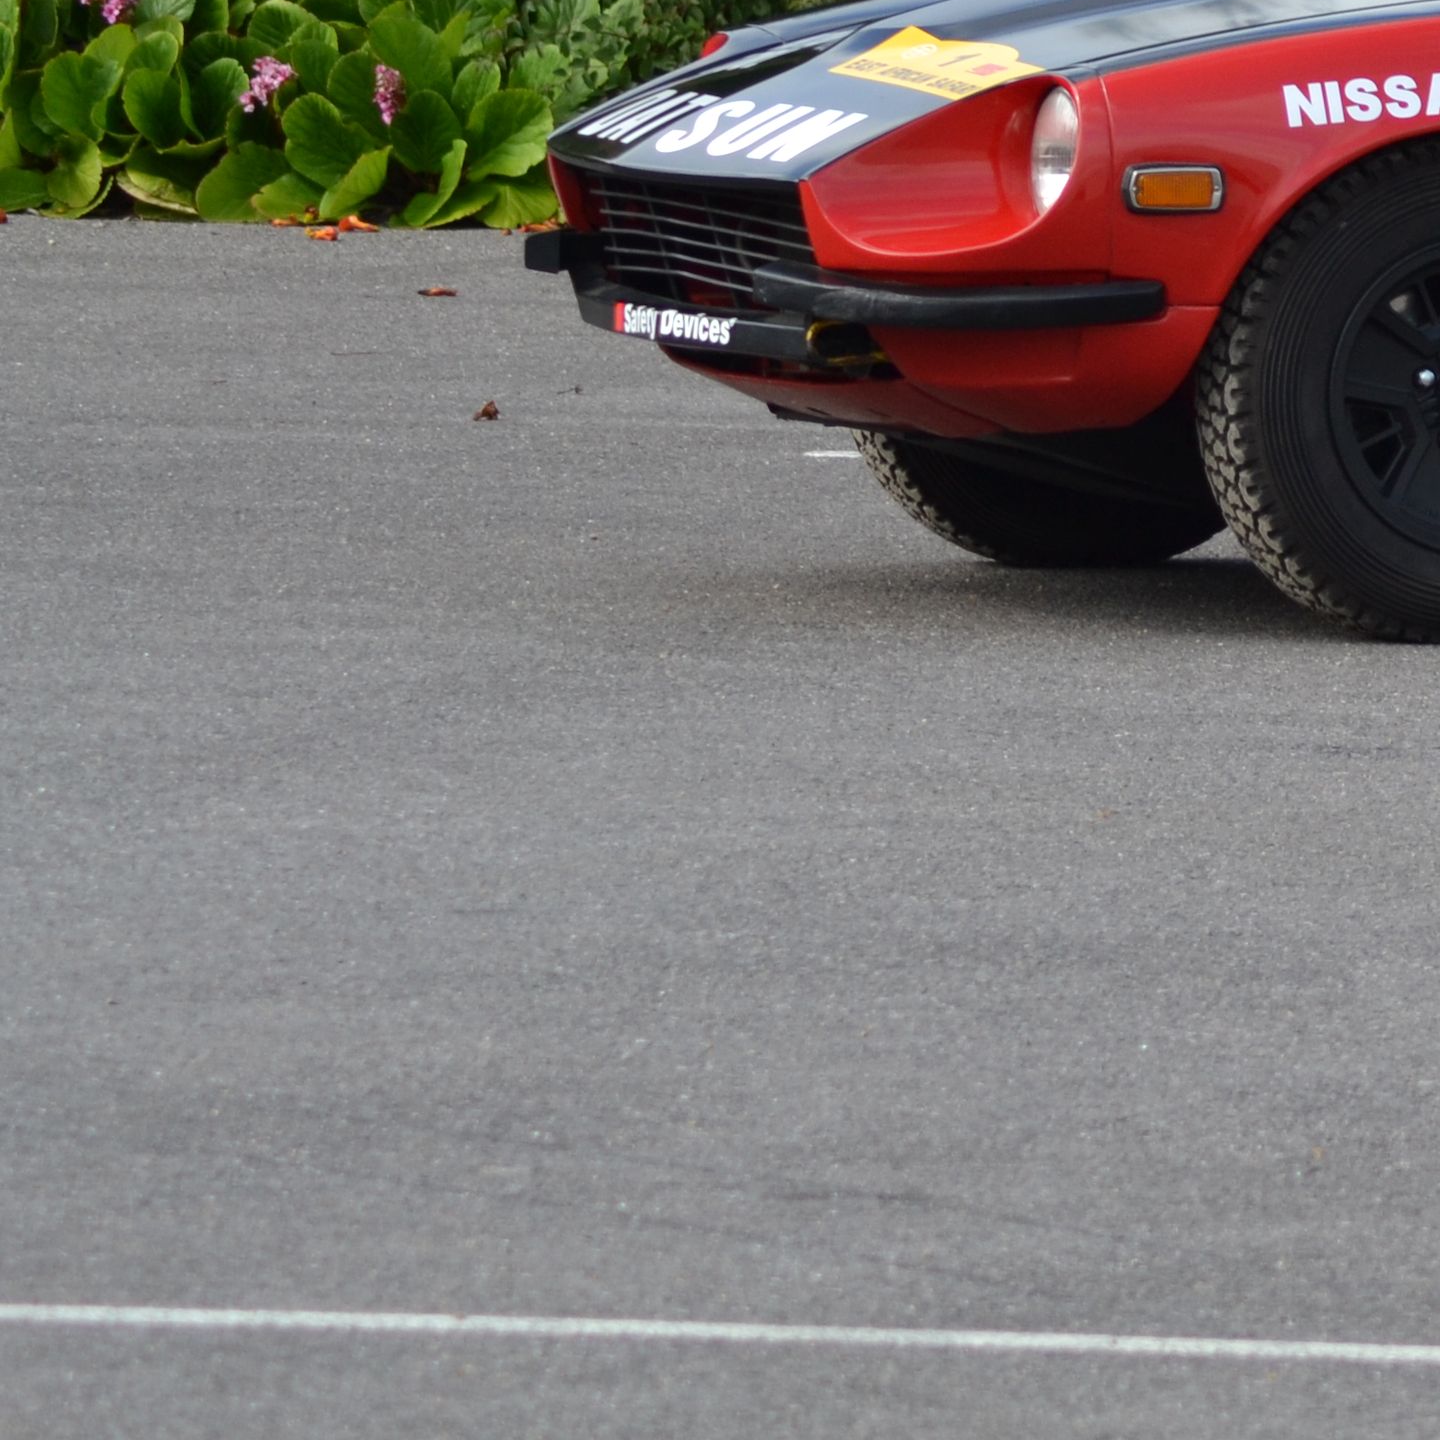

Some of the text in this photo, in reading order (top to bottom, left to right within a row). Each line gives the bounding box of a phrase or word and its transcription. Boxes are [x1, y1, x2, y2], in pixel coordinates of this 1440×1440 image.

[577, 89, 869, 162] DATSUN
[623, 303, 733, 346] Safety Devices
